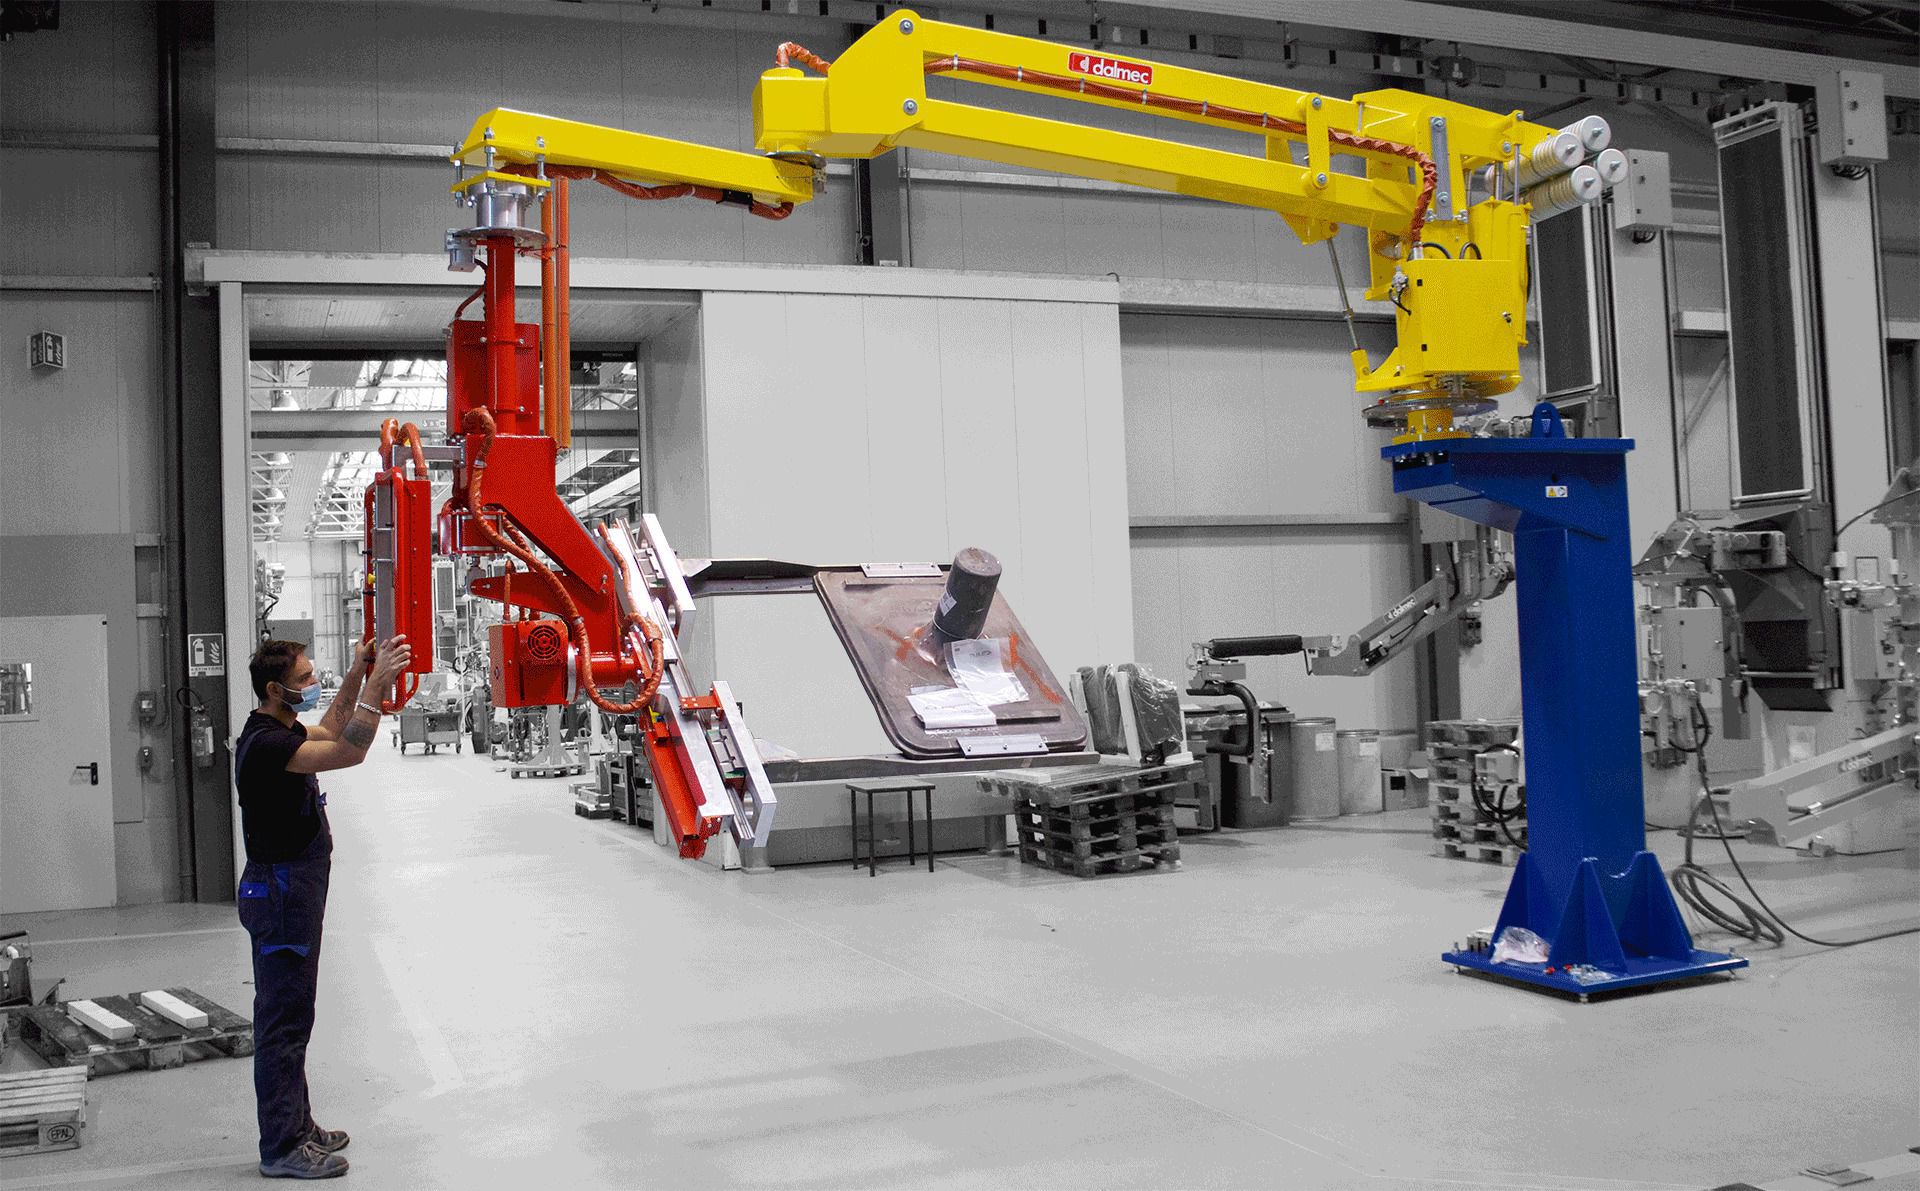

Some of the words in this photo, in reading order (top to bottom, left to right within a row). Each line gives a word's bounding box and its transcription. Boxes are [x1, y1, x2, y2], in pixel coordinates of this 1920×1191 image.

[1092, 58, 1149, 84] dalmec
[1393, 598, 1416, 617] dalmec
[50, 1127, 72, 1140] EPAL
